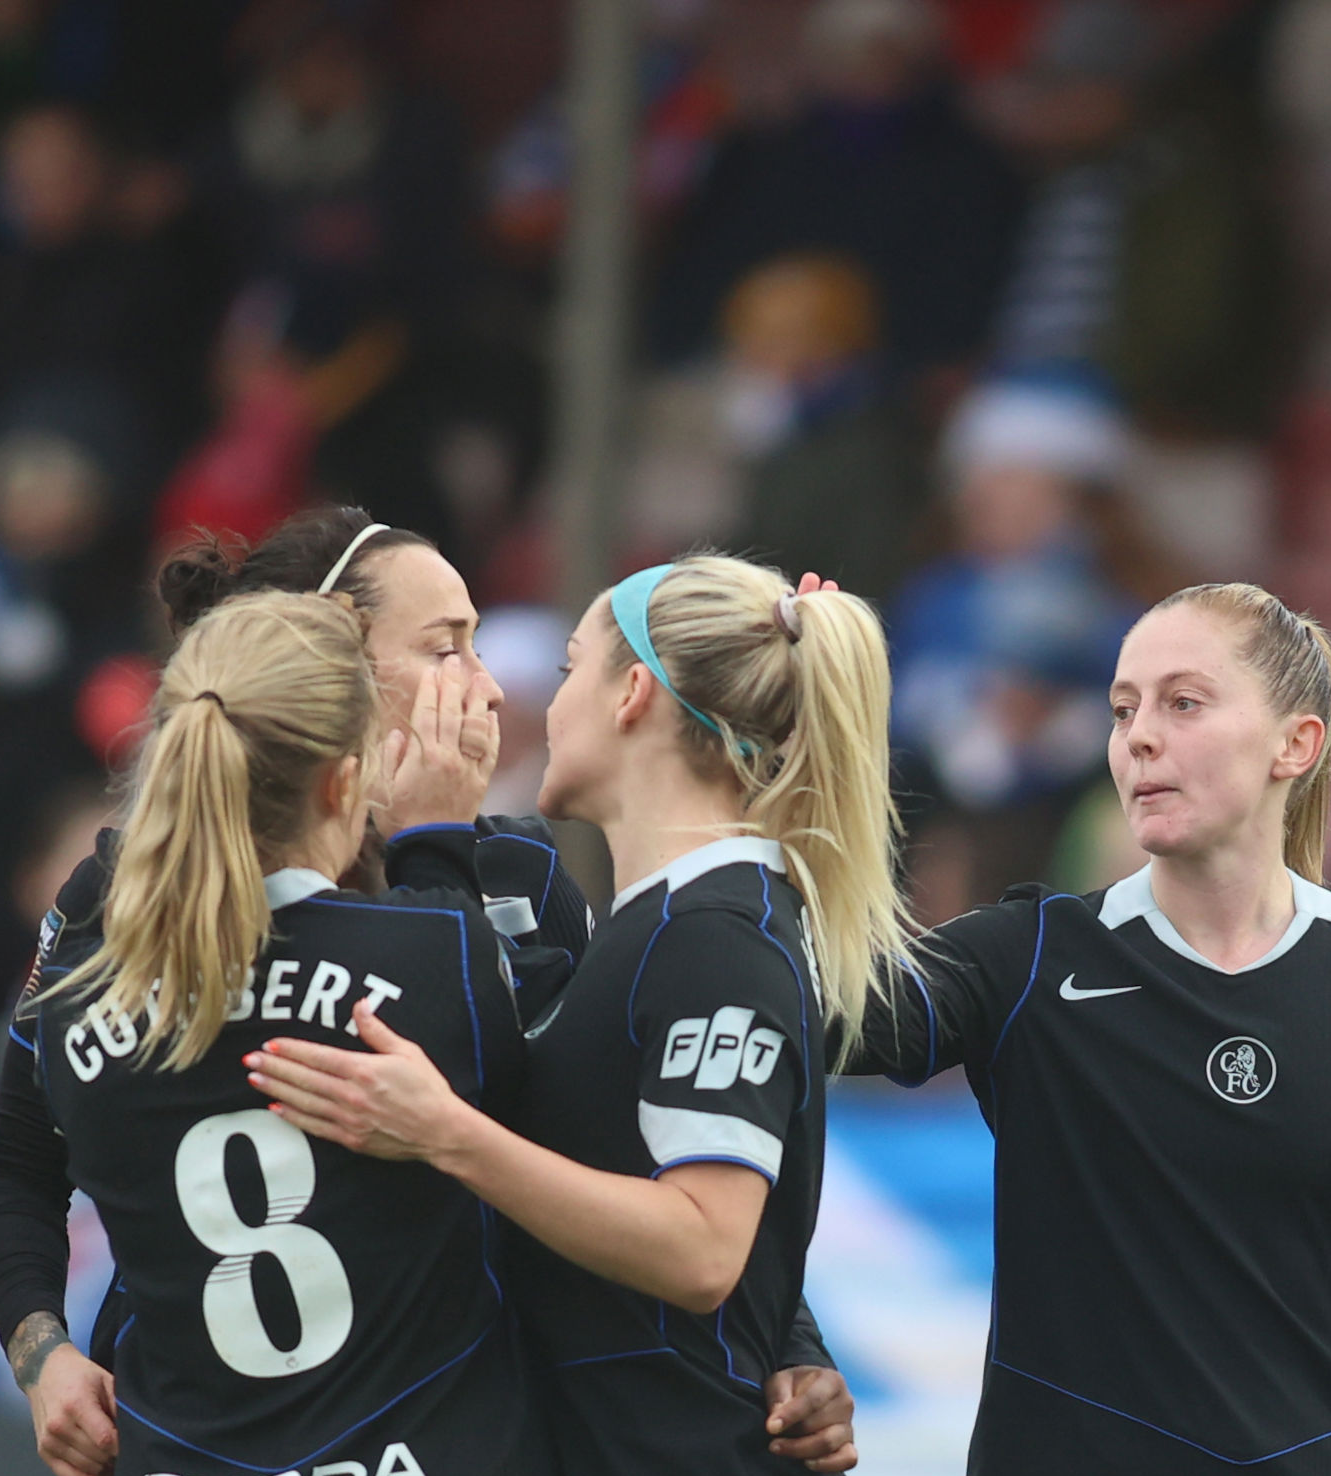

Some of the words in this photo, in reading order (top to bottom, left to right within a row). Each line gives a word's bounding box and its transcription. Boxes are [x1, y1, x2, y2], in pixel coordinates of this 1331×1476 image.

[65, 960, 402, 1082] CUBERT
[664, 1018, 782, 1080] FPT
[175, 1108, 354, 1378] 8
